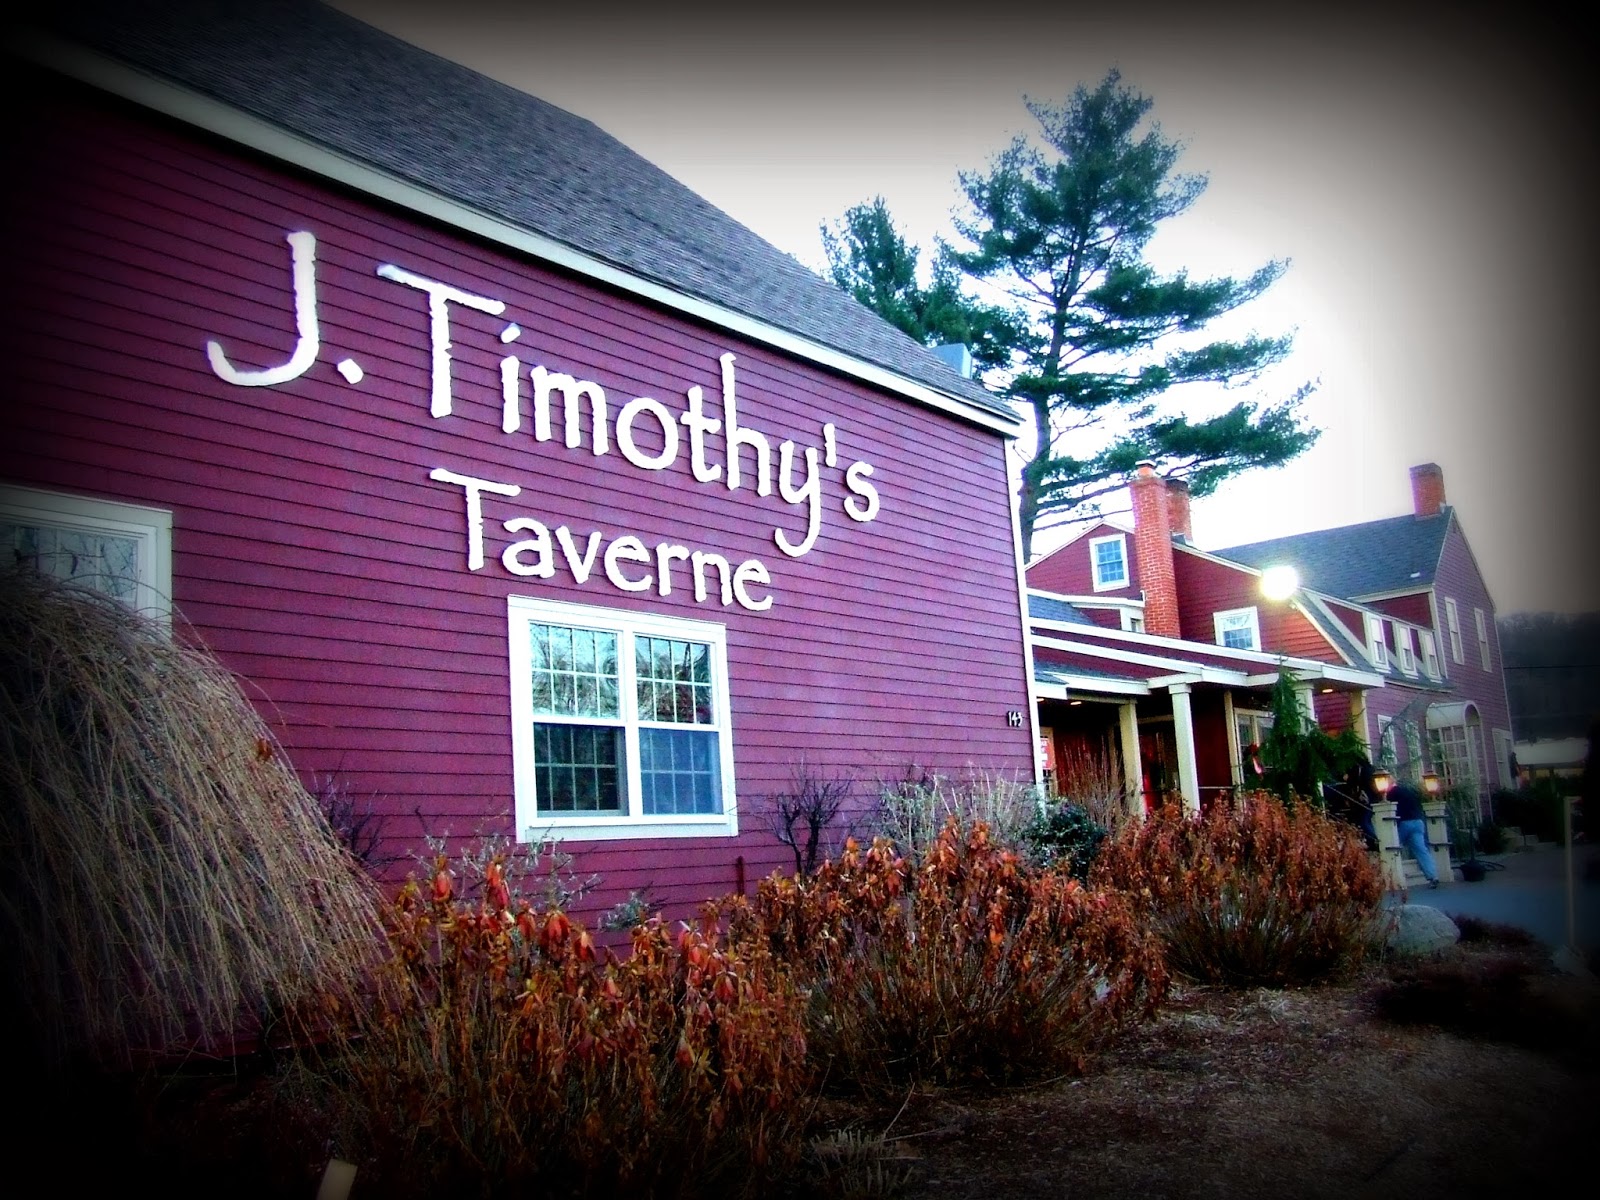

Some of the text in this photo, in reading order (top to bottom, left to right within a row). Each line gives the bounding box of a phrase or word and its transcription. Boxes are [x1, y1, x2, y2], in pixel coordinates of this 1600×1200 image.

[207, 231, 881, 557] J. Timothy's
[430, 468, 773, 611] Taverne
